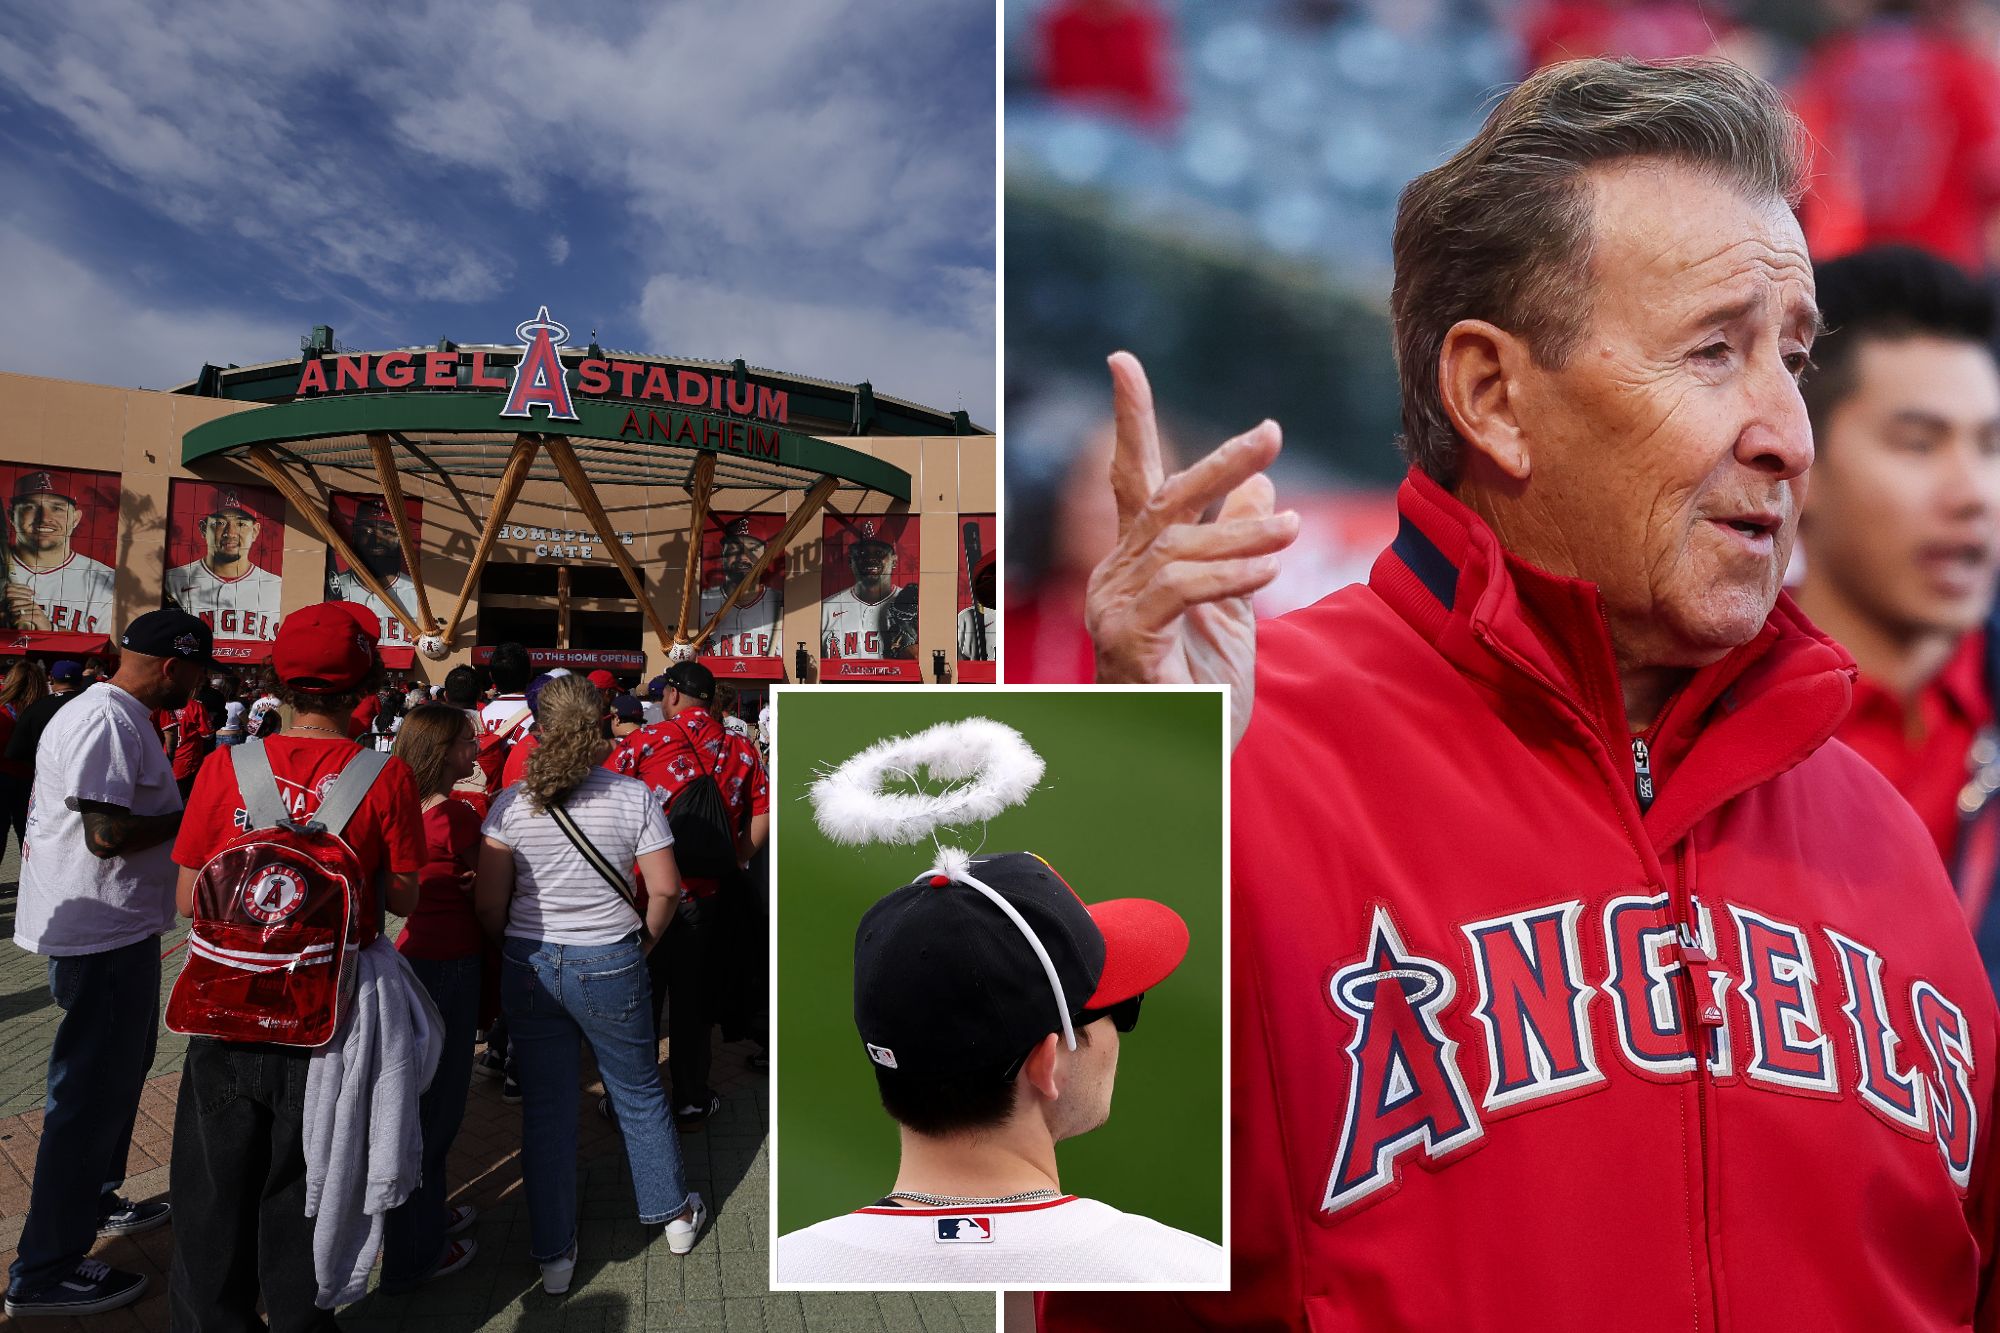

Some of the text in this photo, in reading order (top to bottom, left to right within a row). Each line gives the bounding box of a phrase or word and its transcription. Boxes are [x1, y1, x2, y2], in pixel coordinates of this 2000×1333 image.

[296, 351, 507, 395] ANGEL
[577, 358, 789, 425] STADIUM
[619, 407, 780, 460] ANAHEIM
[498, 524, 633, 545] HOMEPLAE
[534, 543, 593, 559] GATE
[531, 652, 643, 664] TO THE HOME OPENER
[1320, 894, 1980, 1214] ANGELS
